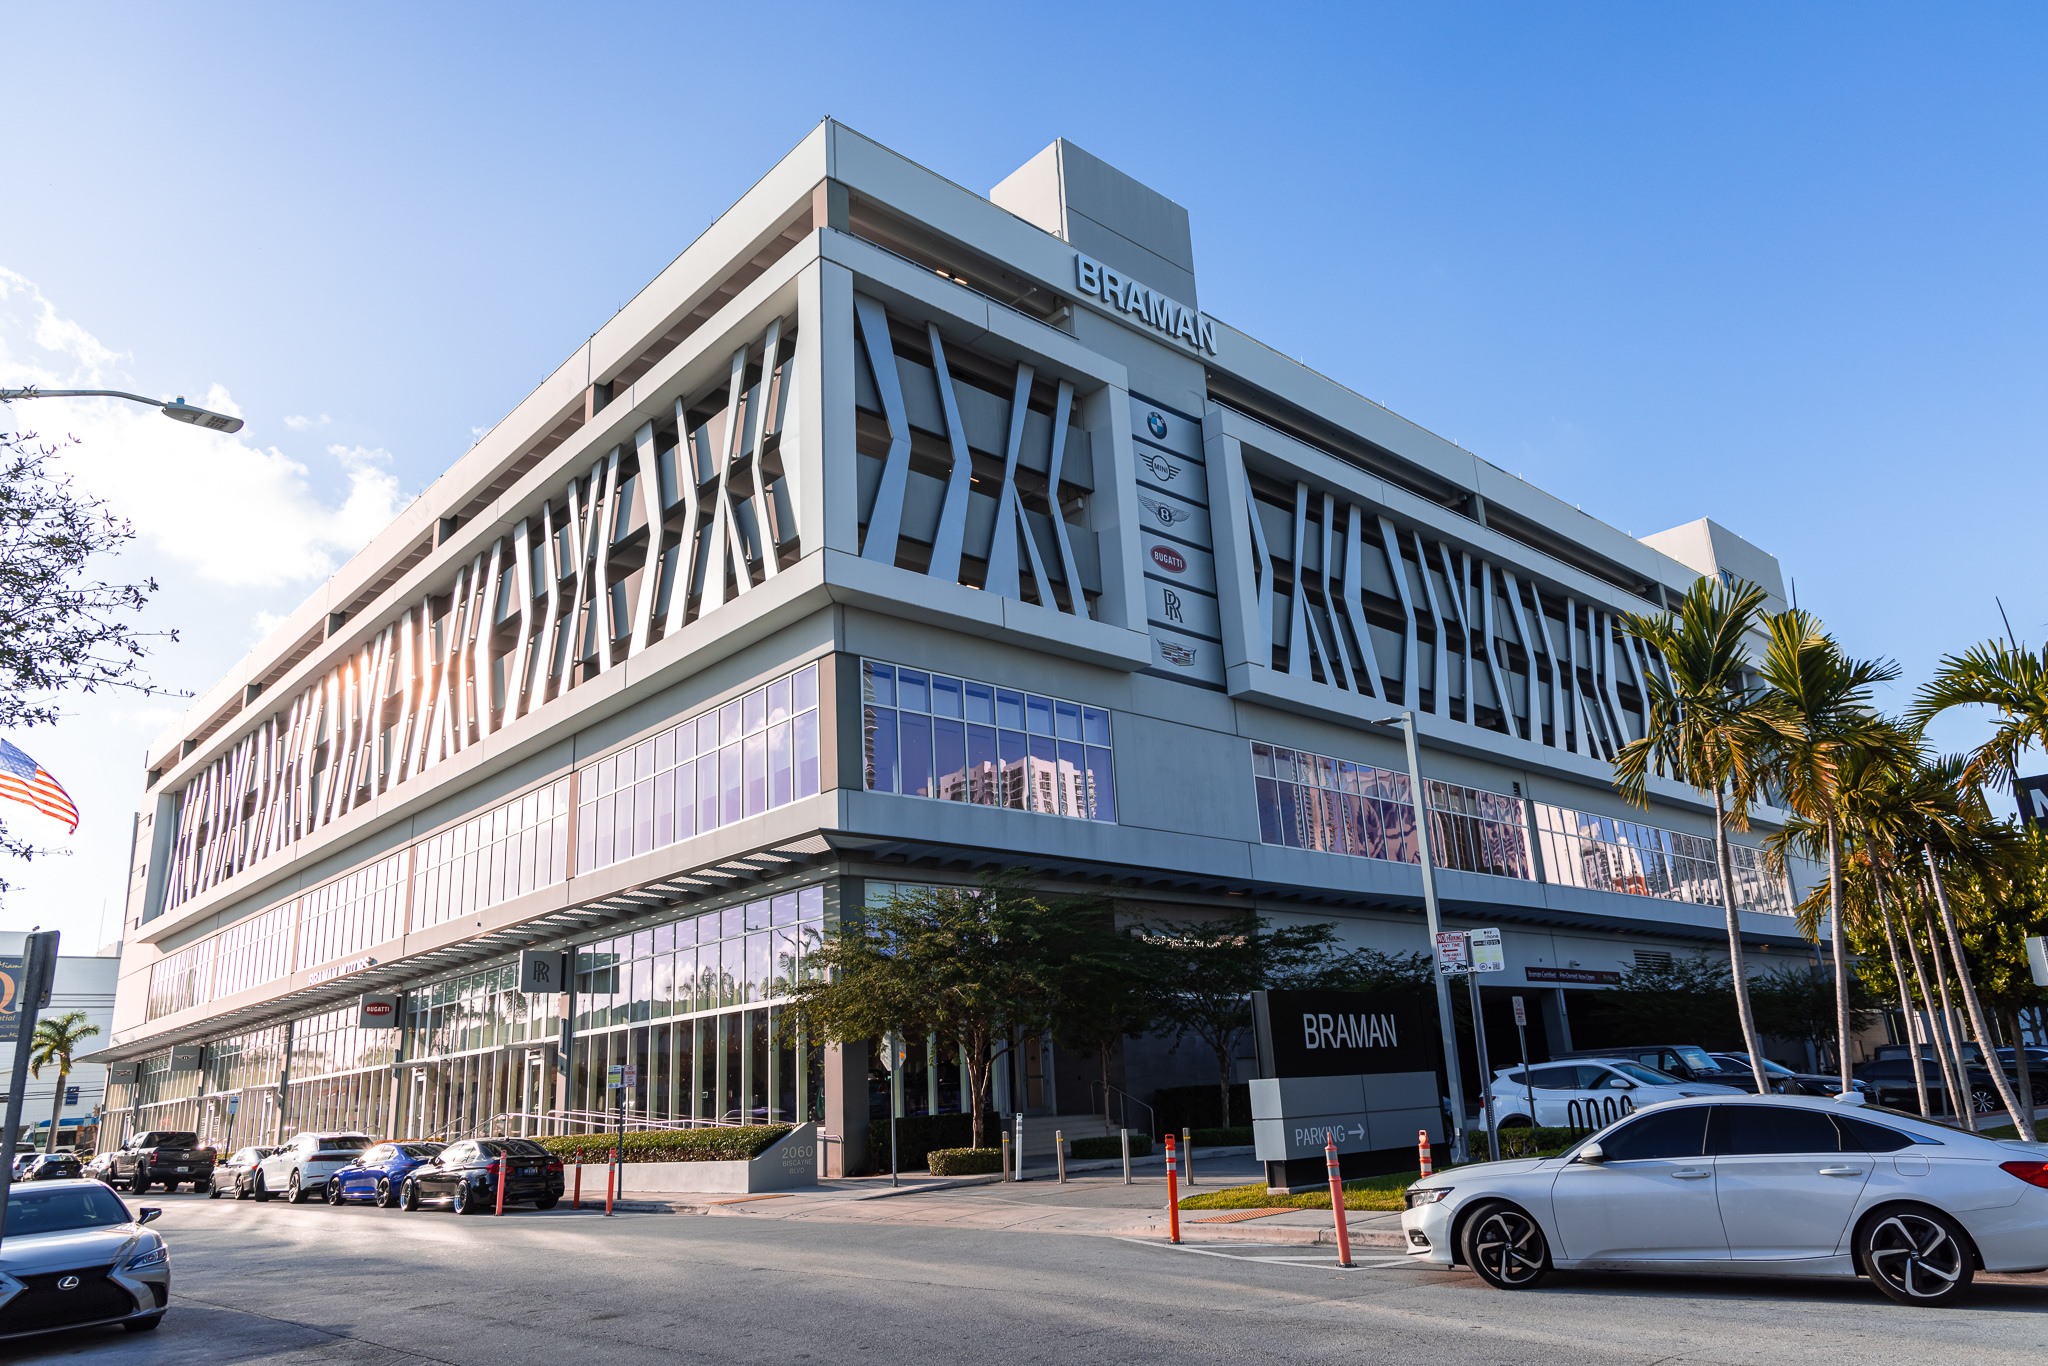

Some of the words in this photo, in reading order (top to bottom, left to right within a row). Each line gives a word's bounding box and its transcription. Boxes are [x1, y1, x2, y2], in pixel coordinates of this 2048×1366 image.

[1075, 253, 1217, 356] BRAMAN
[1154, 463, 1169, 474] MINI
[1154, 551, 1183, 568] BUGATTI
[1437, 935, 1446, 943] NO
[1303, 1013, 1398, 1049] BRAMAN
[782, 1145, 813, 1159] 2060
[782, 1159, 813, 1167] BISCAYNE
[789, 1167, 805, 1175] BLVD
